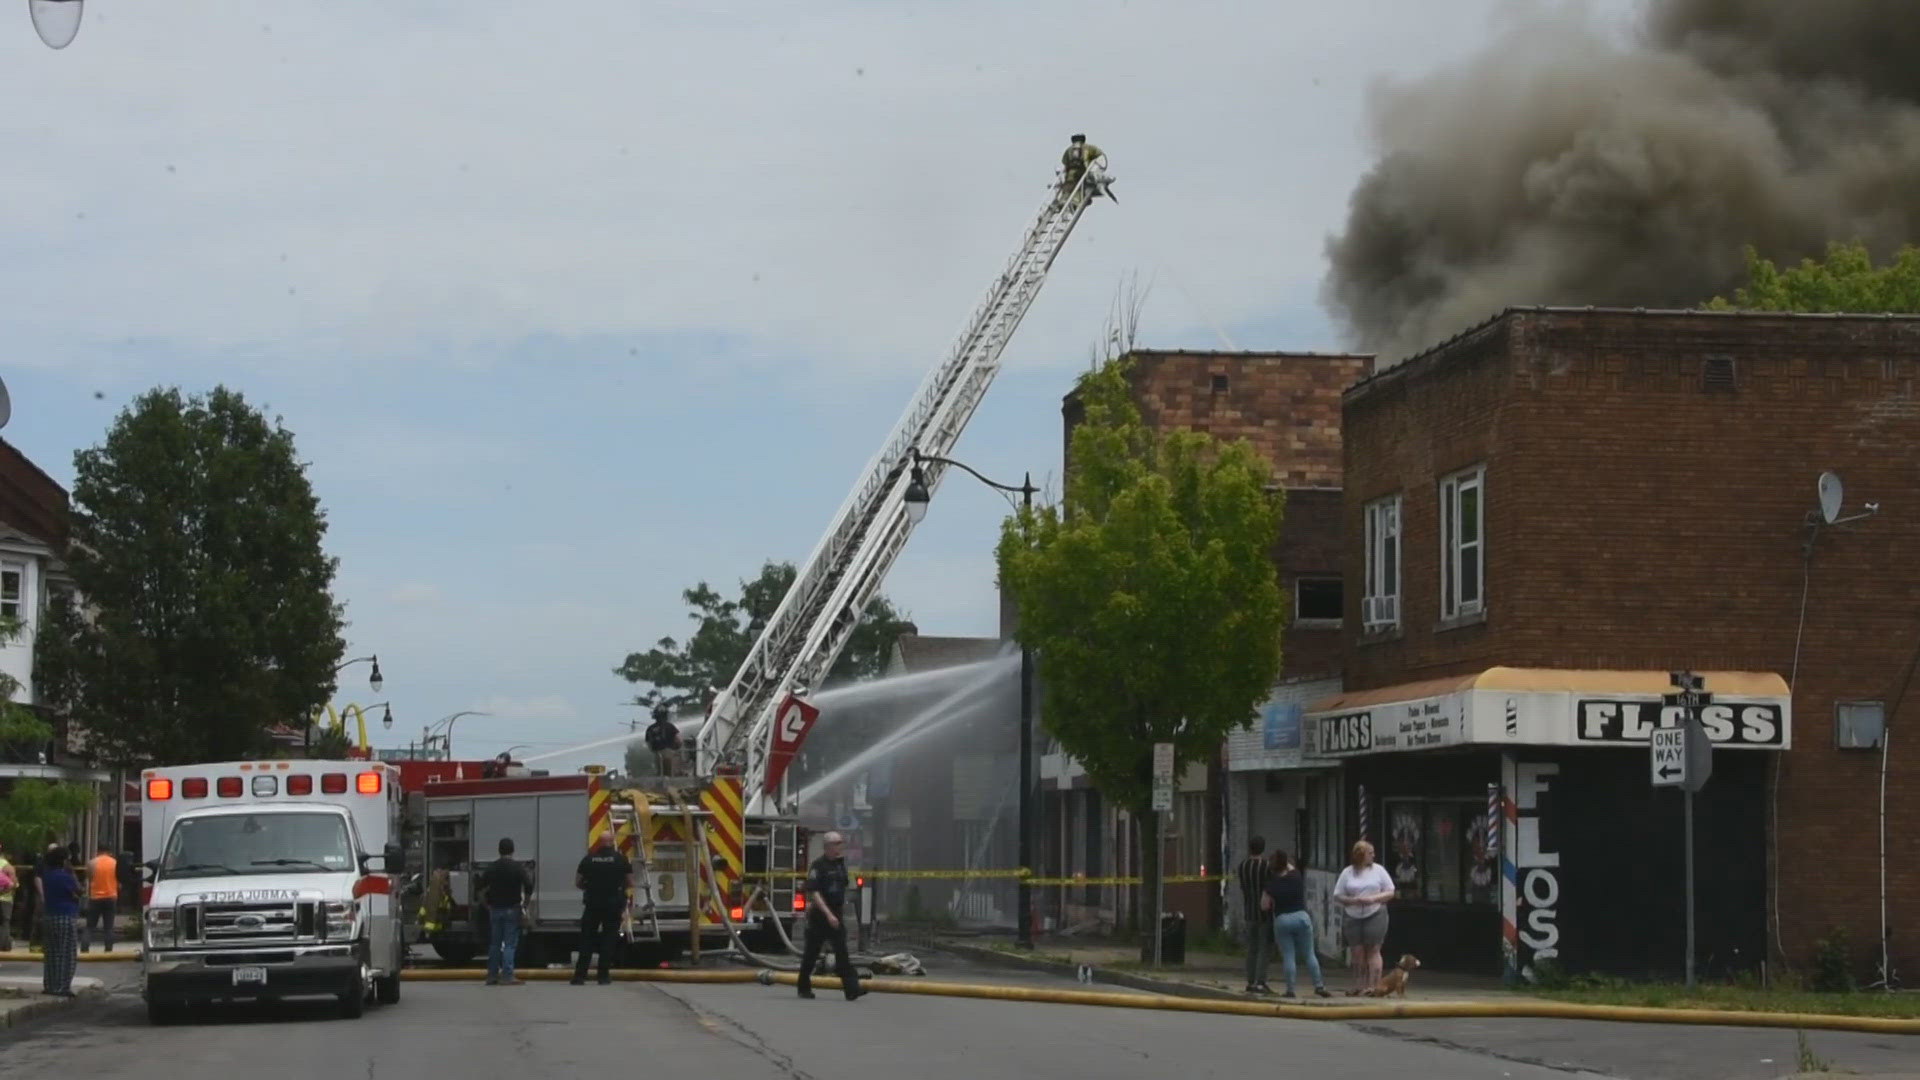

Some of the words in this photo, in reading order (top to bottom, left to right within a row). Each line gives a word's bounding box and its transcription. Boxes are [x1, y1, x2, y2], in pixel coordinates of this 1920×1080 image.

[1322, 714, 1370, 751] FLOSS
[1655, 732, 1682, 746] ONE
[1655, 747, 1683, 762] WAY
[658, 874, 675, 901] 3
